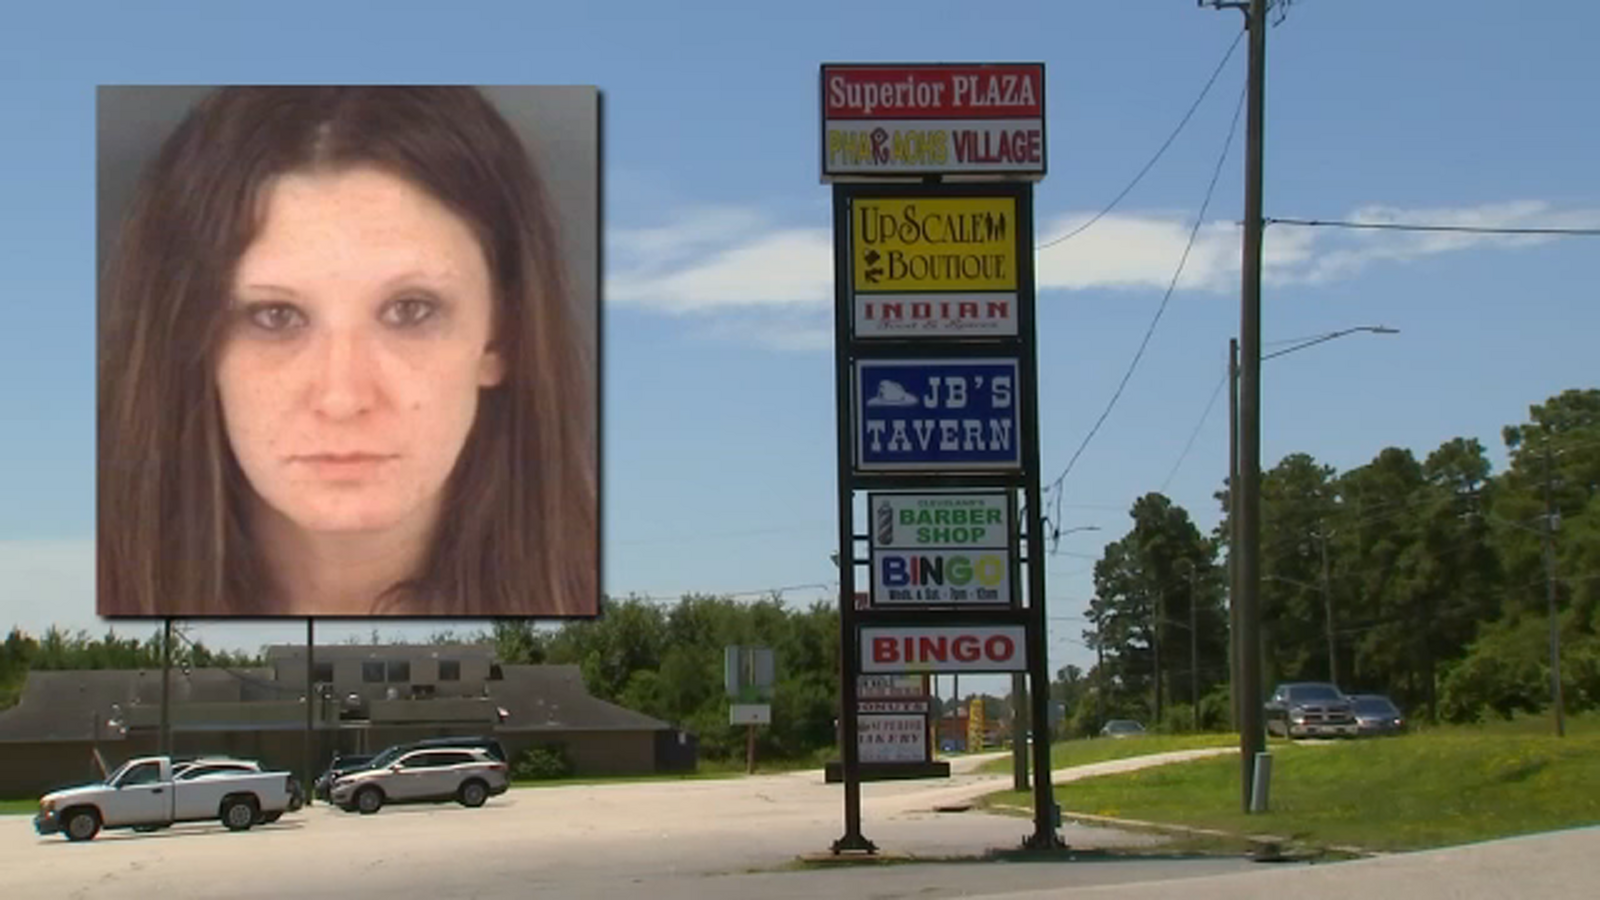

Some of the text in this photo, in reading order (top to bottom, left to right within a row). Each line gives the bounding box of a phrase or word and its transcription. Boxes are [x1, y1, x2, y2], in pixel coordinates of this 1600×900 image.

[829, 75, 1036, 114] Superior PLAZA
[952, 130, 1040, 163] VILLAGE
[887, 250, 1006, 280] BOUTIQUE
[864, 302, 1009, 320] INDIAN
[923, 376, 1012, 408] JB'S
[866, 419, 1012, 452] TAVERN
[900, 509, 1002, 525] BARBER
[916, 527, 986, 544] SHOP
[882, 556, 1004, 586] BINGO
[872, 635, 1016, 664] BINGO
